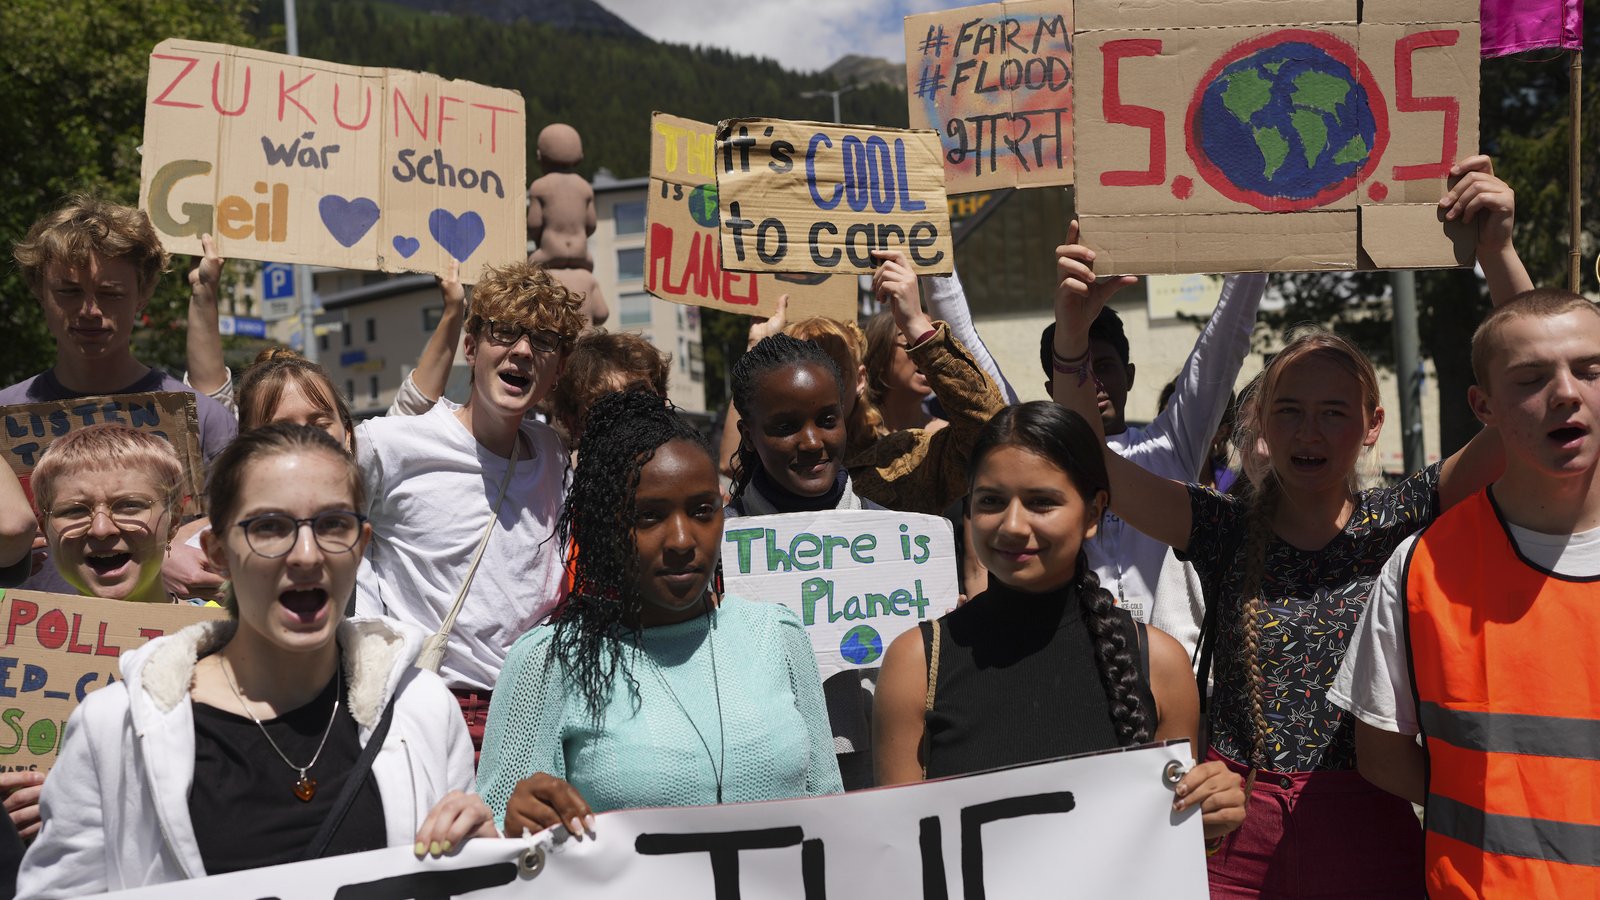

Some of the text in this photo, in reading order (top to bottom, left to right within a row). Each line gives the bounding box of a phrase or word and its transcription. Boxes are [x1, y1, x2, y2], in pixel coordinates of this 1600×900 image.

[152, 53, 519, 154] ZUKUNFT
[946, 108, 1069, 177] भारत
[148, 159, 290, 241] Geil
[805, 132, 926, 214] COOL
[725, 201, 944, 268] to care
[271, 270, 286, 296] P
[6, 401, 161, 438] LISTEN
[11, 442, 49, 466] T
[725, 523, 931, 574] There is
[6, 598, 121, 658] POLL
[801, 577, 930, 626] Planet
